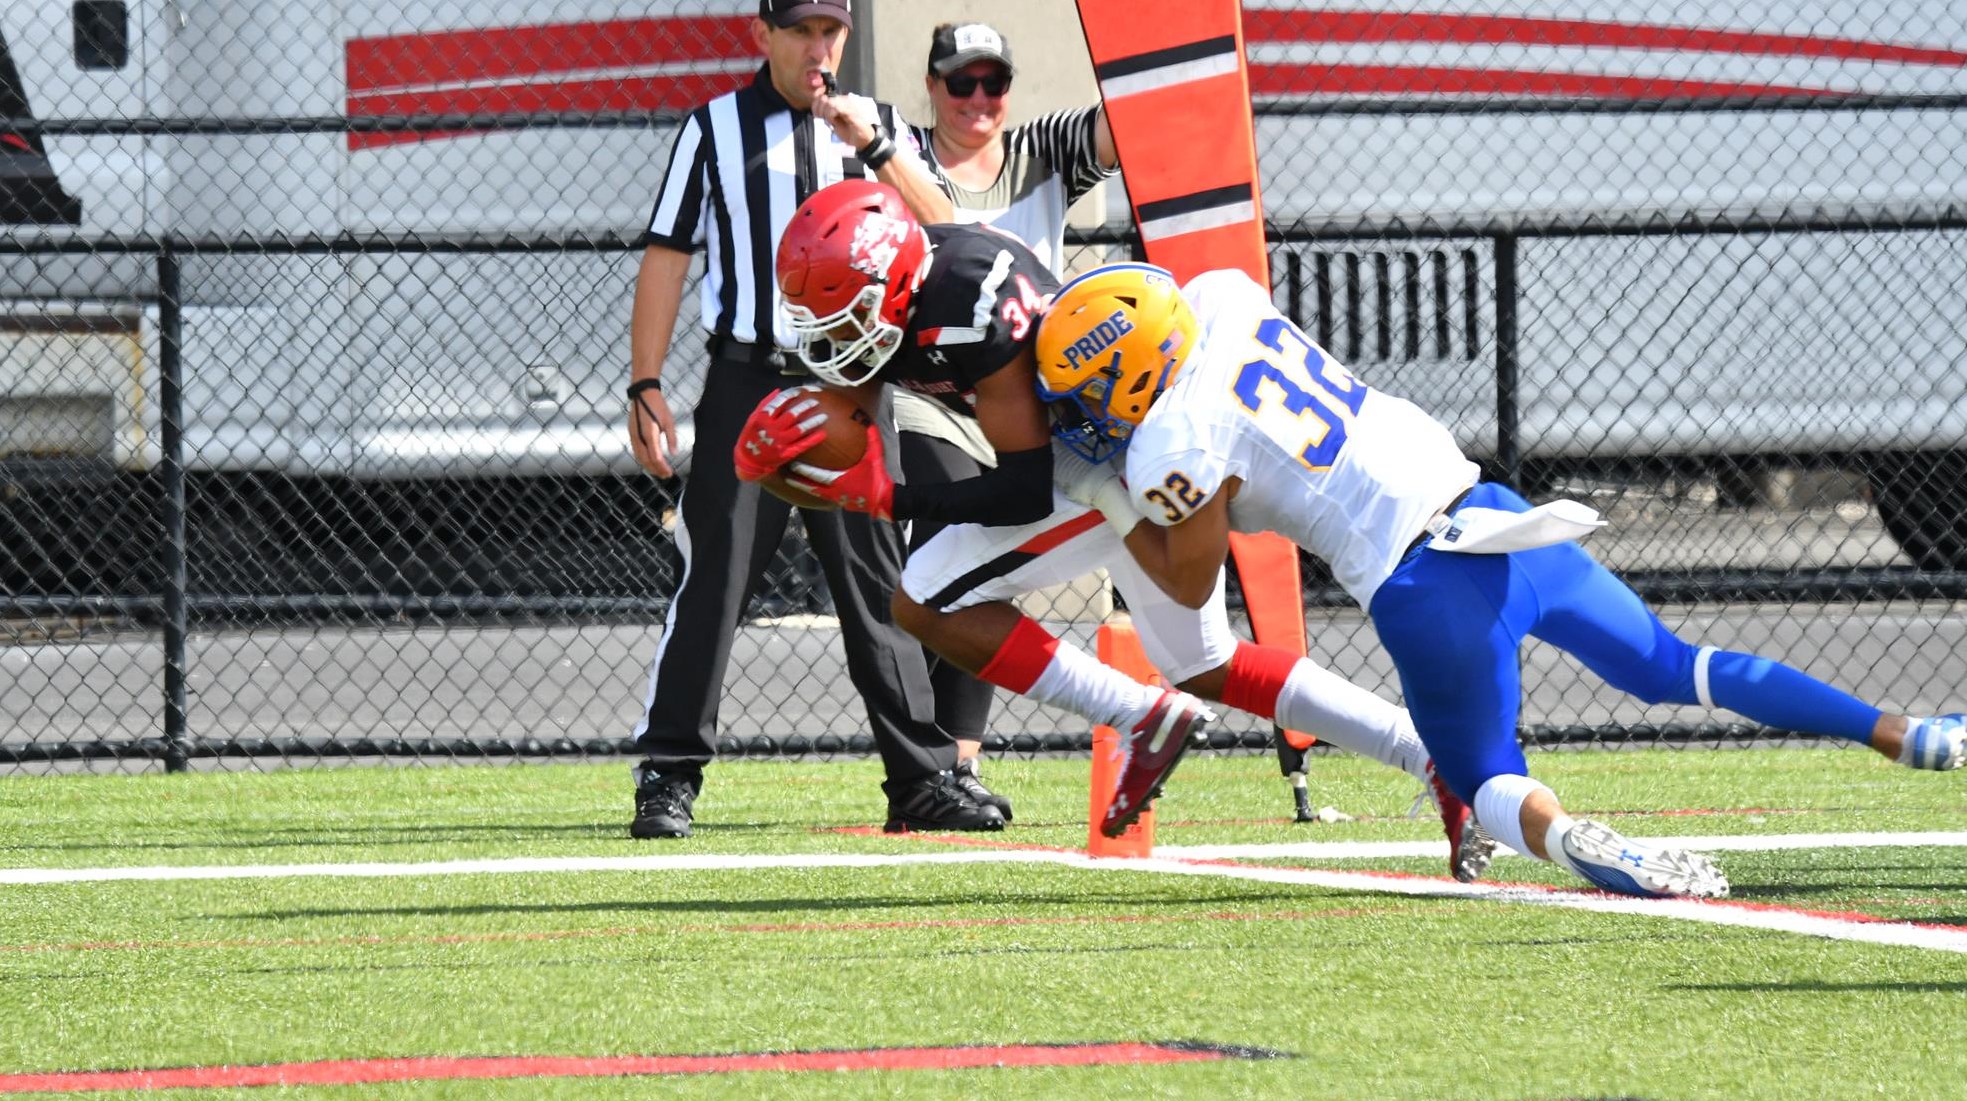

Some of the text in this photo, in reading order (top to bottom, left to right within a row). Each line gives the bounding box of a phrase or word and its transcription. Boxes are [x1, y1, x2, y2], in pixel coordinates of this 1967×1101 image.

[1001, 272, 1049, 341] 34
[1062, 309, 1134, 371] PRIDE
[1231, 317, 1368, 472] 32
[1145, 471, 1206, 522] 32
